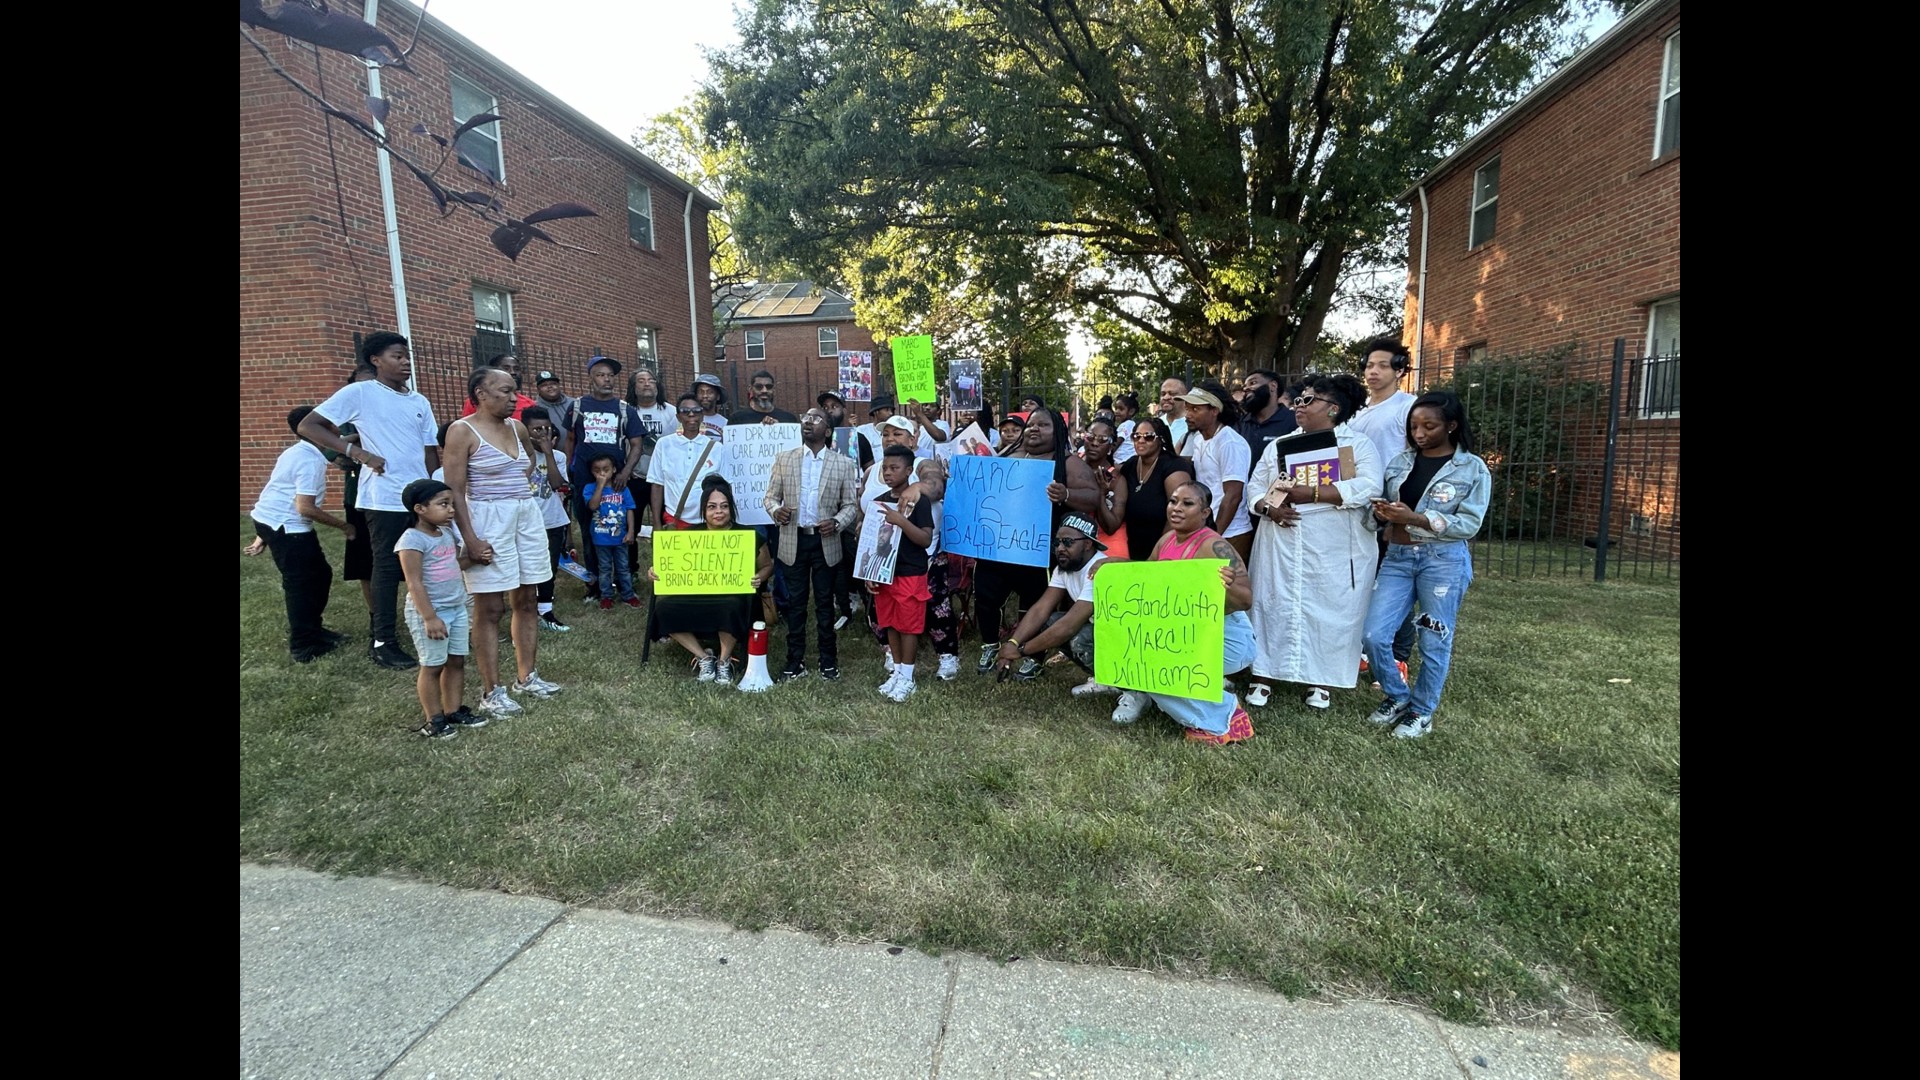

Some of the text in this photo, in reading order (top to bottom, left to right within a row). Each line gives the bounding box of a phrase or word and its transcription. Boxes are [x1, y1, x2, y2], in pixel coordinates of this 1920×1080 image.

[901, 338, 919, 349] MARC
[907, 350, 914, 360] IS
[896, 358, 931, 372] BALD EAGLE
[899, 370, 927, 383] BRING HIM
[902, 381, 929, 393] BACK HOME
[745, 427, 764, 441] DPR
[768, 426, 798, 440] REALLY
[732, 443, 784, 460] CARE ABOUT
[949, 457, 1024, 494] MARC
[1065, 515, 1095, 535] FLORIDA
[660, 534, 744, 550] WE WILL NOT
[660, 551, 745, 572] BE SILENT!
[665, 572, 744, 587] BRING BACK MARC
[1096, 585, 1120, 622] We
[1120, 582, 1170, 625] Stand
[1113, 658, 1210, 693] Williams
